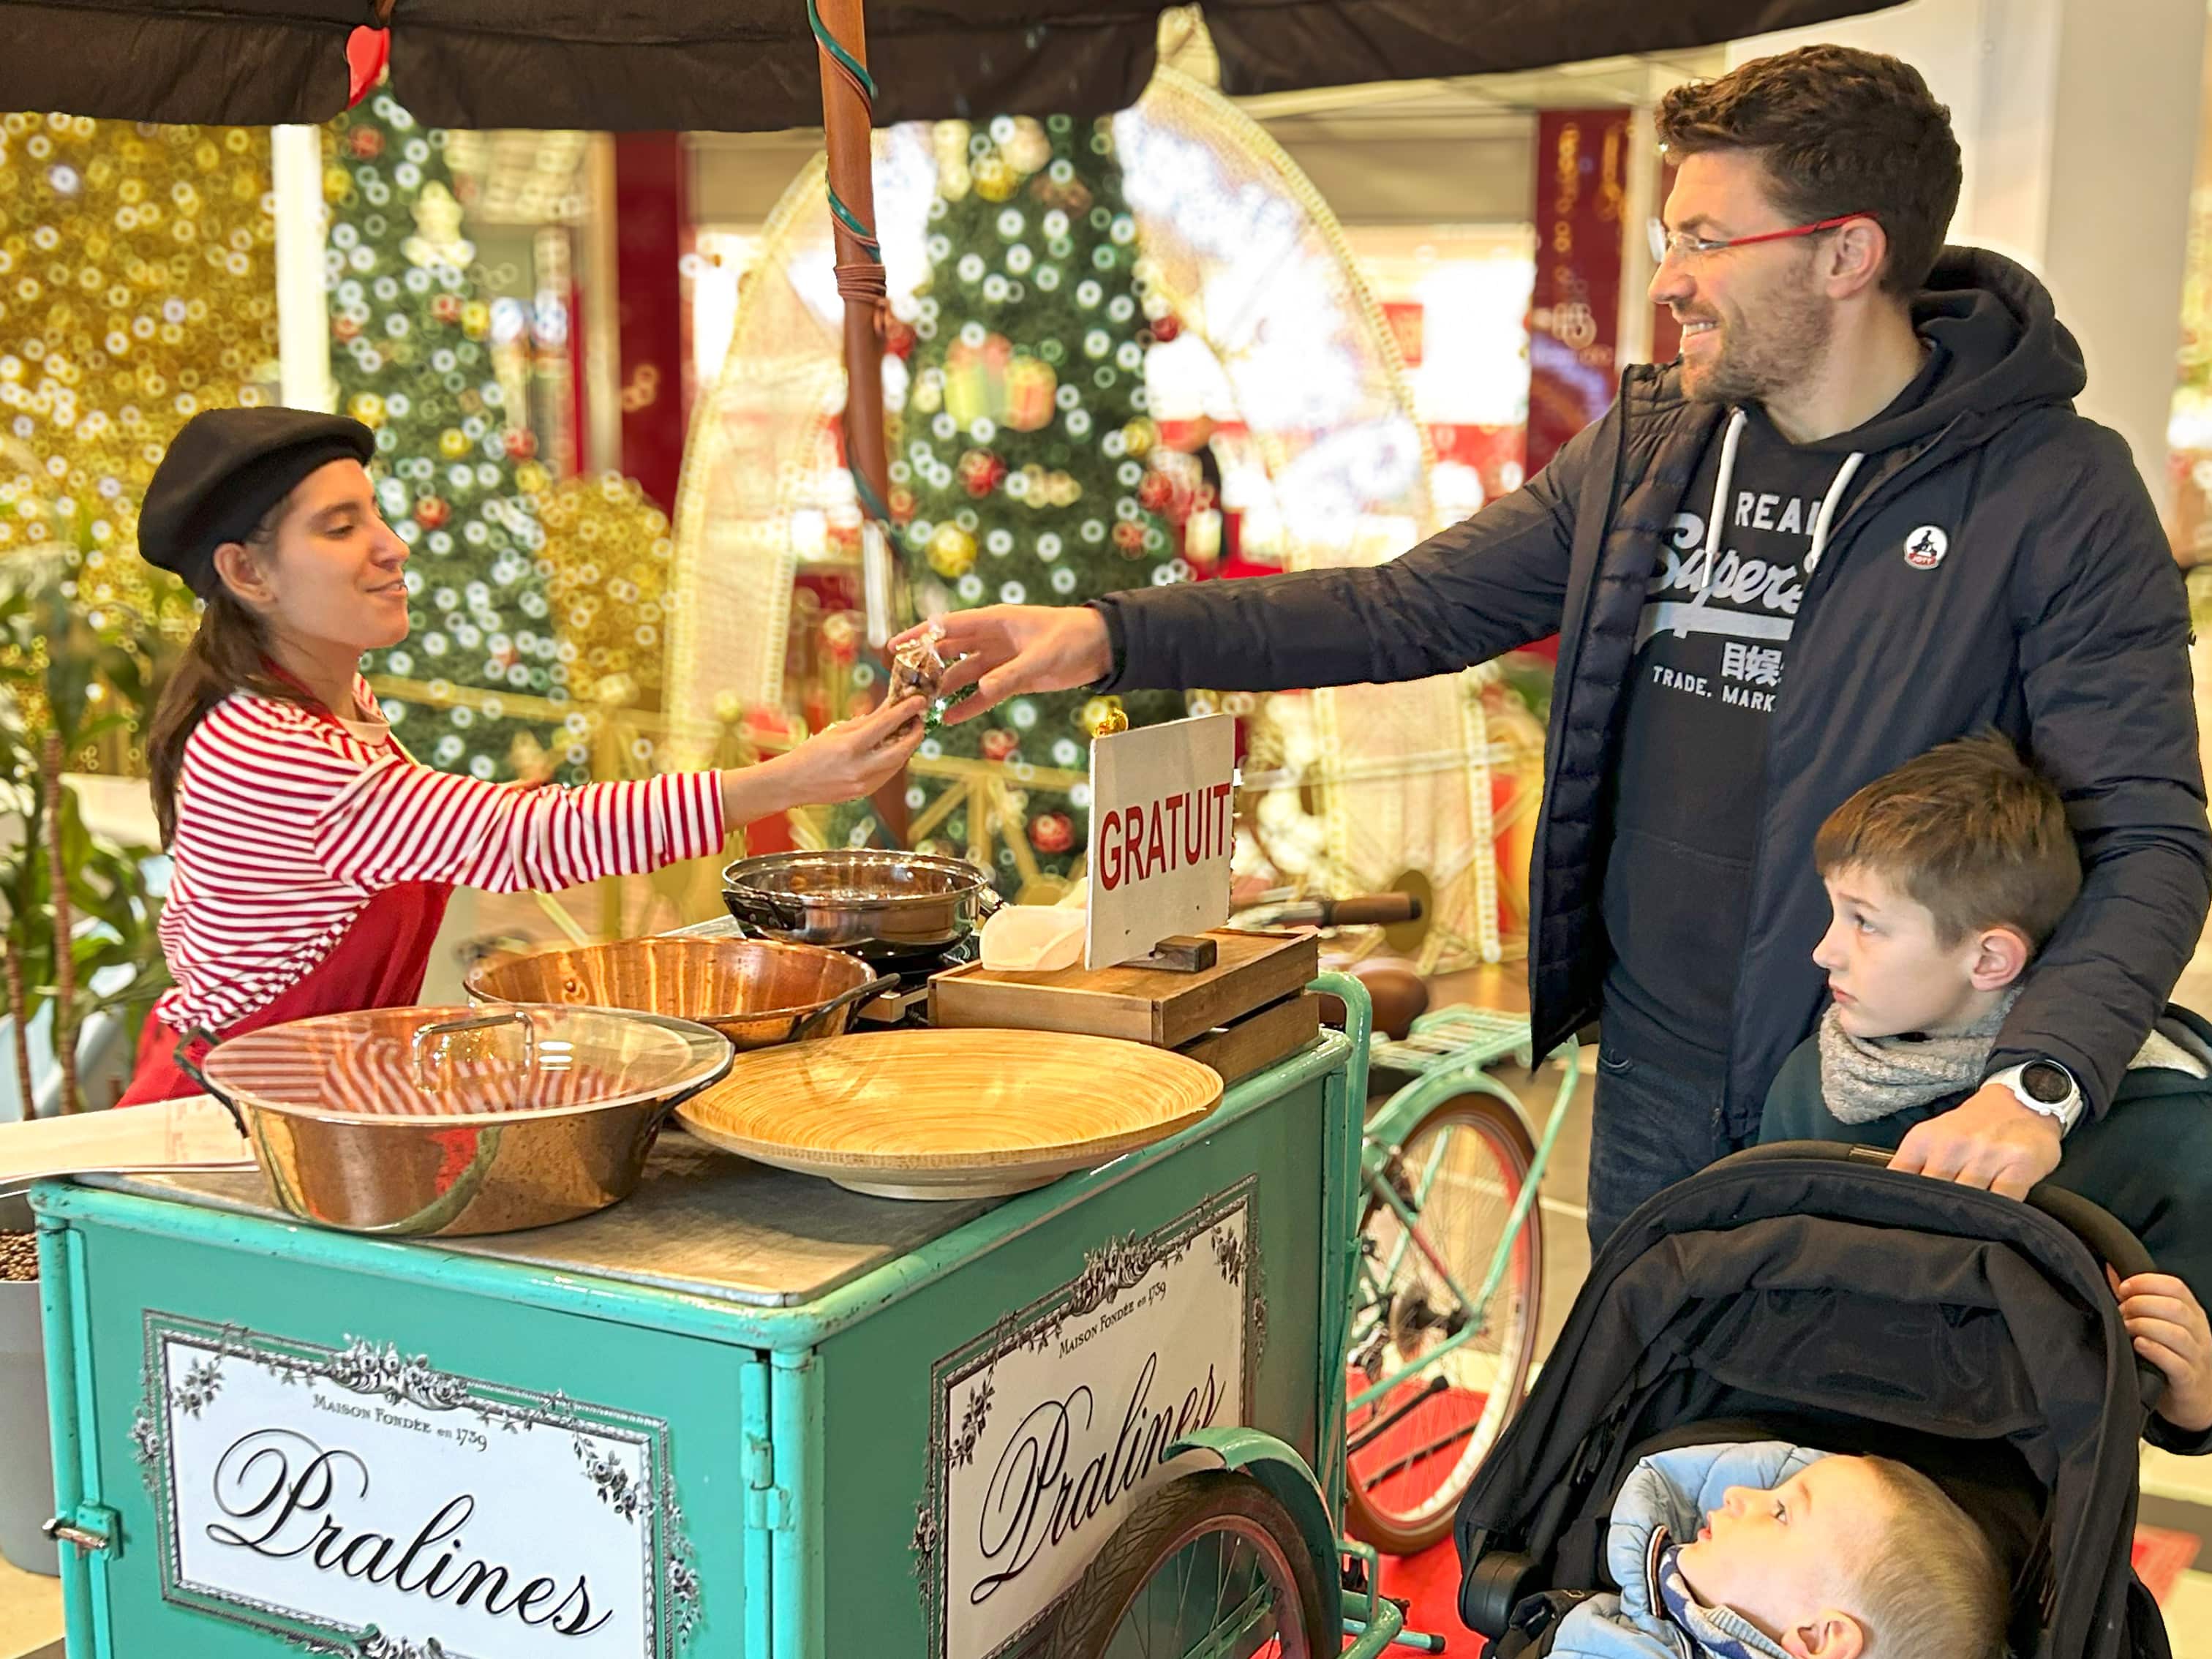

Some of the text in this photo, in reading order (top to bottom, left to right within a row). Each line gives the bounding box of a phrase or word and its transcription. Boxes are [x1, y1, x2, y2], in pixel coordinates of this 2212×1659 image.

[1099, 782, 1231, 891] GRATUIT
[1059, 1324, 1098, 1358] MAISON
[312, 1393, 371, 1421] MAISON
[437, 1428, 453, 1439] en
[971, 1351, 1227, 1605] Pralines
[206, 1428, 613, 1638] Pralines
